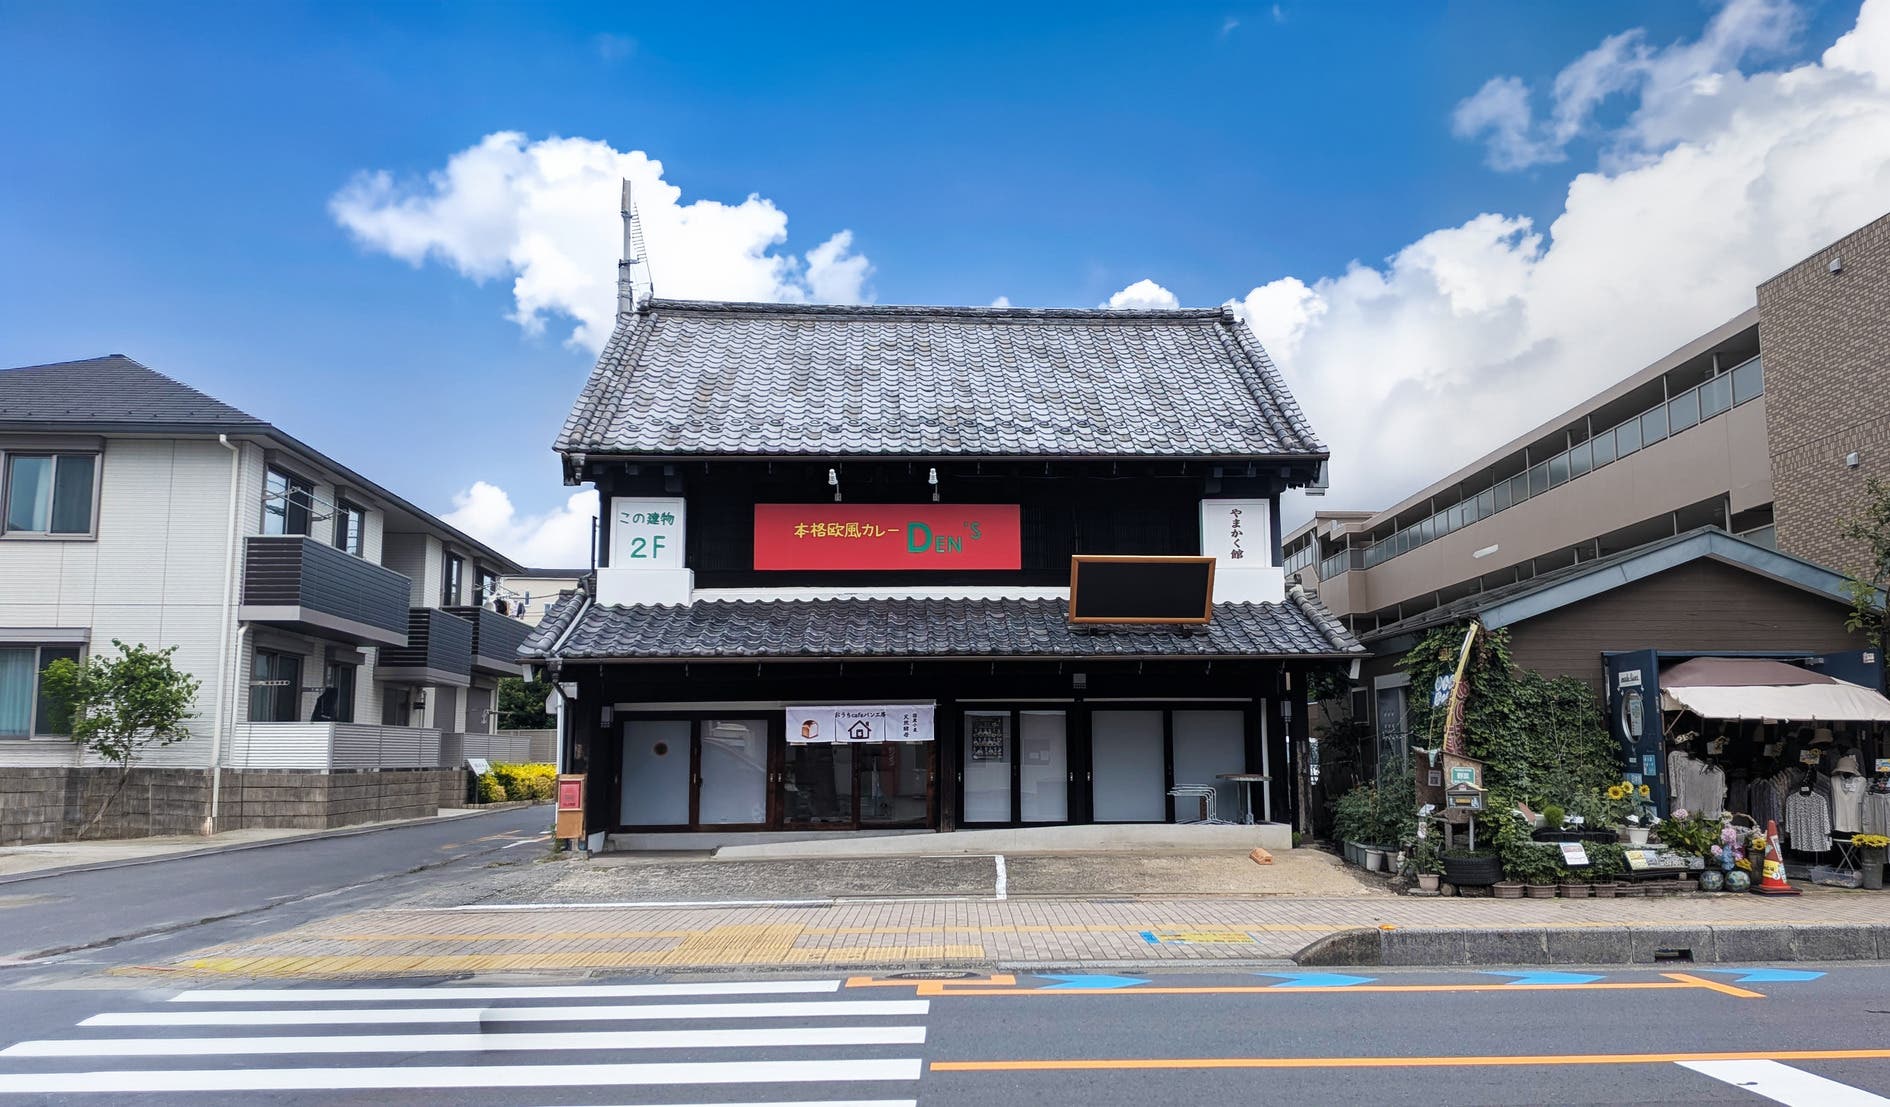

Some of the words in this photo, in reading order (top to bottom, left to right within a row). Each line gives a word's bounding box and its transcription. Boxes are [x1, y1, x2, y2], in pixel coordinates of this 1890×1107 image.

[620, 511, 675, 526] この建物
[794, 522, 899, 539] 本格欧風カレー
[1230, 508, 1244, 560] やまかく館
[630, 535, 666, 559] 2F
